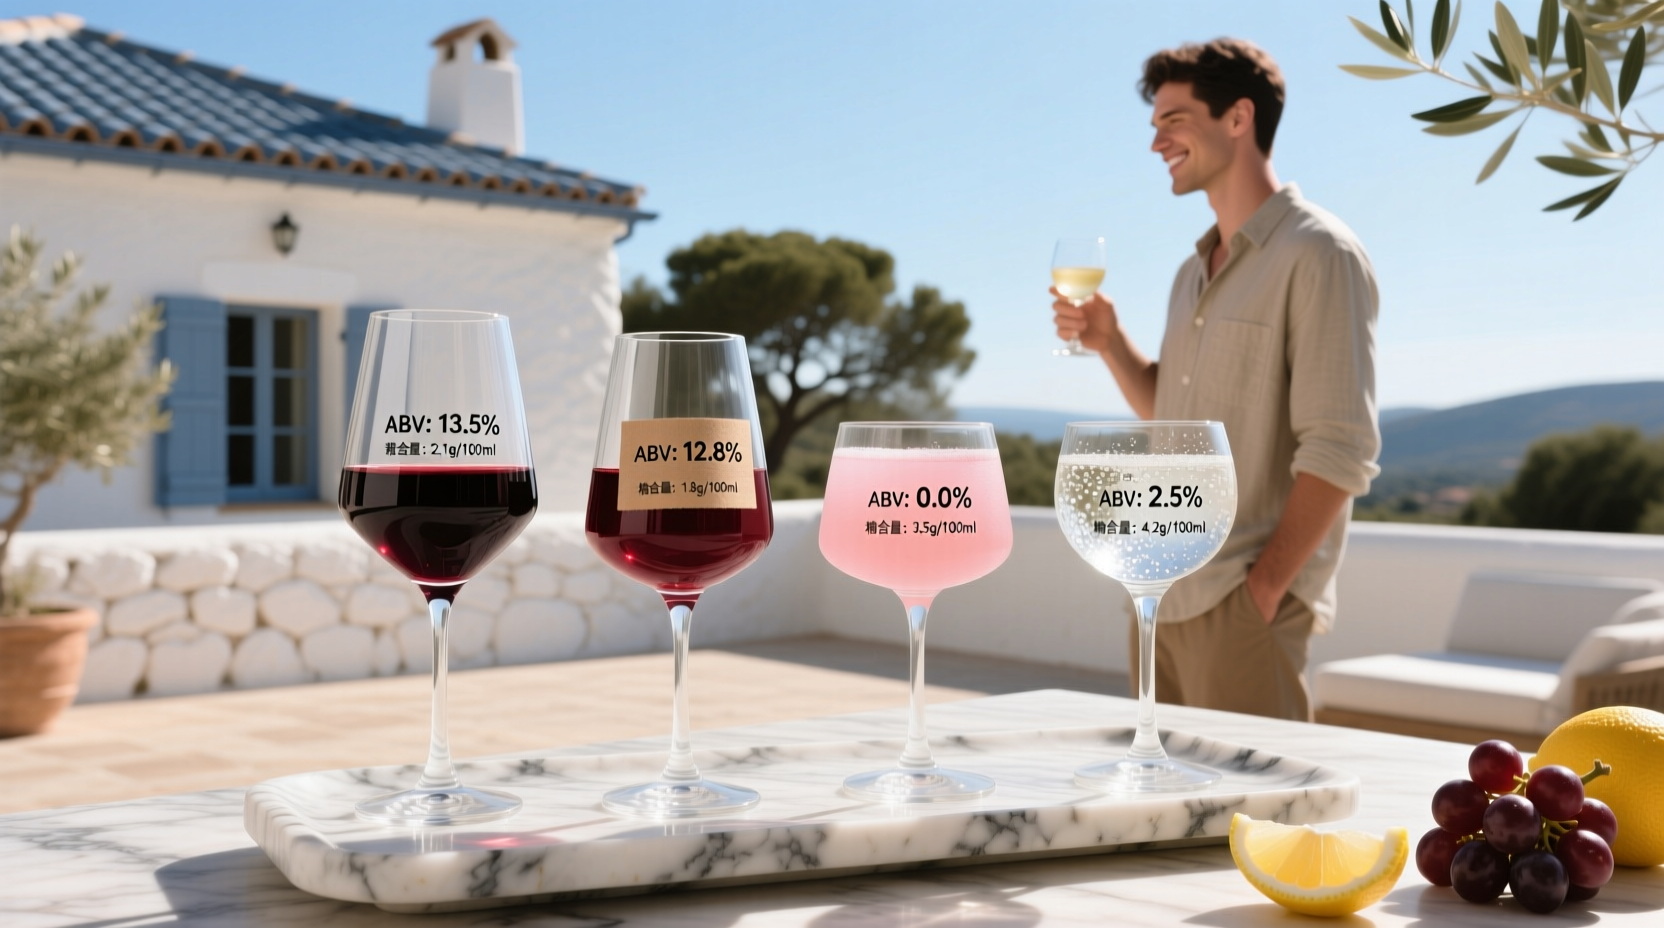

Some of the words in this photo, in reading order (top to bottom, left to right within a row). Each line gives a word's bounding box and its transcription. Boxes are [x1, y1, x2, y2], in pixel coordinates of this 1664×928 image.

[385, 415, 431, 433] ABV:
[438, 413, 500, 436] 13.5%
[634, 444, 677, 463] ABV:
[683, 440, 742, 463] 12.8%
[868, 490, 909, 508] ABV:
[916, 486, 972, 509] 0.0%
[1099, 489, 1142, 508] ABV:
[1148, 485, 1203, 508] 2.5%
